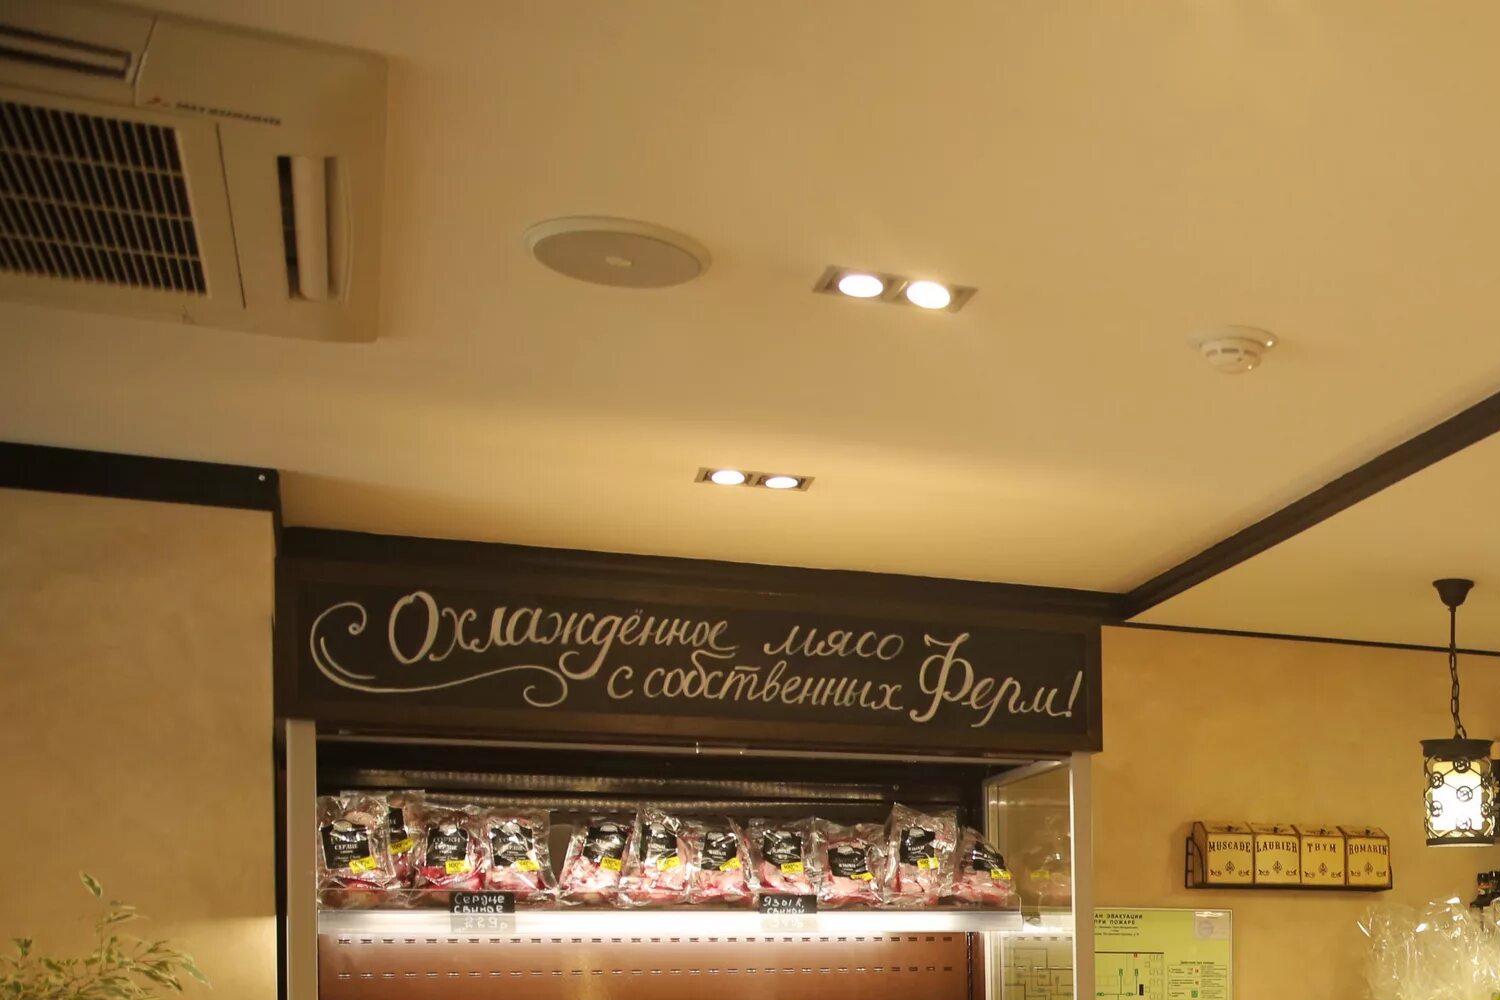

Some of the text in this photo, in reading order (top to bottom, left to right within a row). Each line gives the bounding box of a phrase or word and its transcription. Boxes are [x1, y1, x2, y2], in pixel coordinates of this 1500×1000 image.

[389, 591, 904, 680] Охлаждённое мясо
[606, 665, 633, 699] с
[643, 648, 904, 711] собственных
[1208, 841, 1389, 856] MUSCADE LAURIER THYM ROMARIN
[454, 892, 505, 906] Сердце
